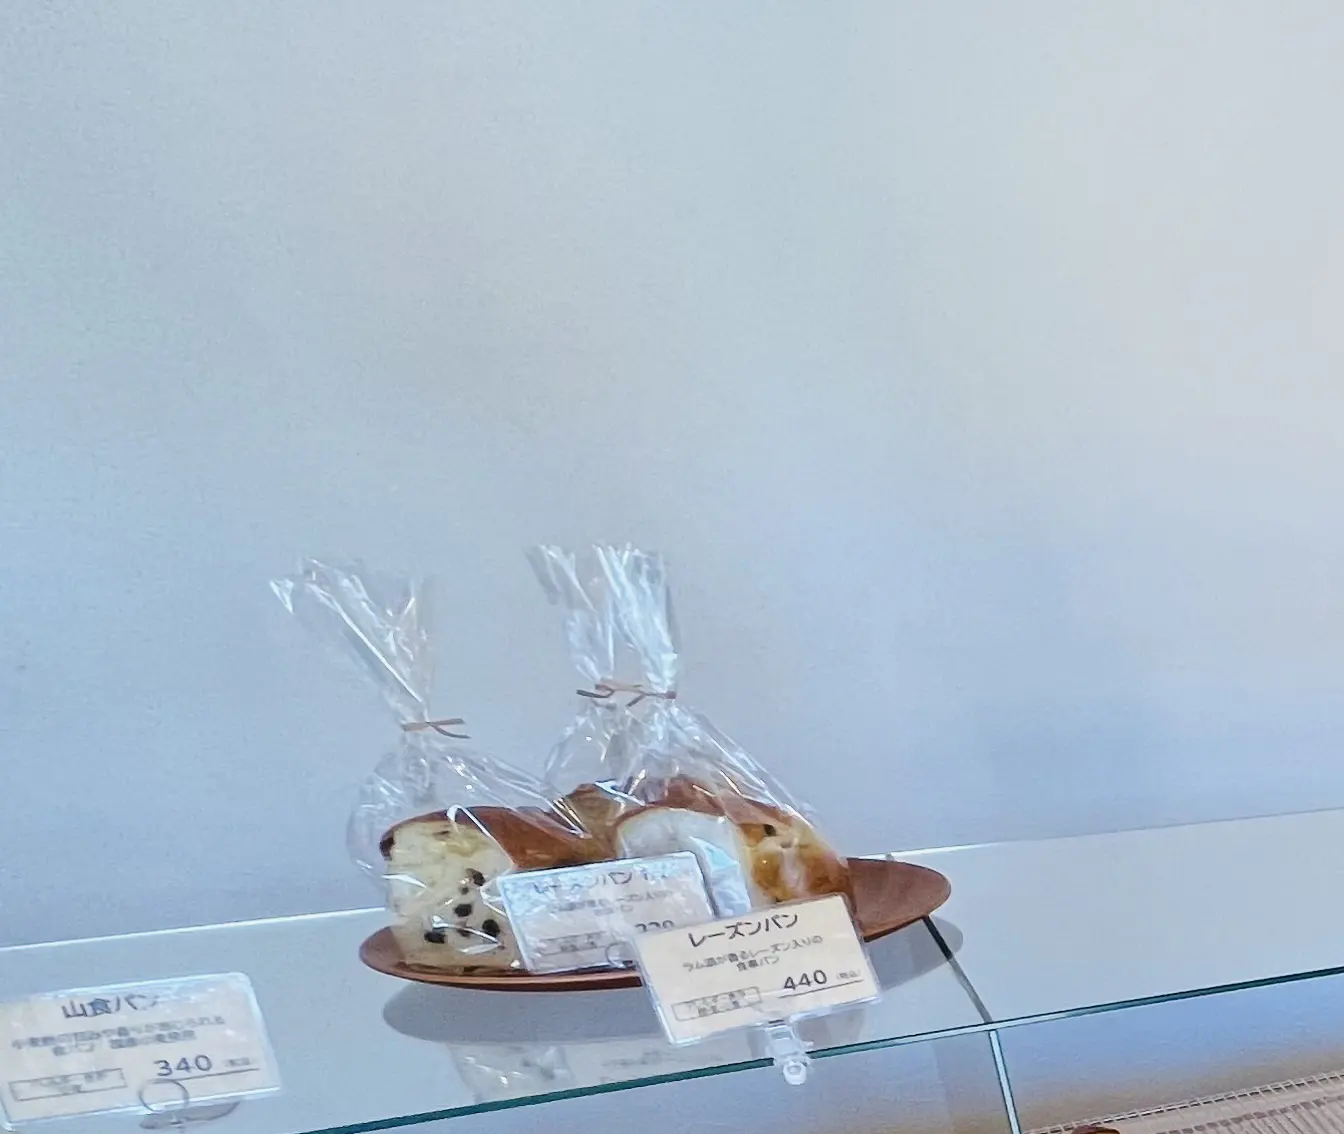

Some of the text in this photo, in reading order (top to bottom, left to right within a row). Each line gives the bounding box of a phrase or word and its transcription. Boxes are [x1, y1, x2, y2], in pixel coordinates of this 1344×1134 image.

[688, 914, 798, 947] レーズンパン
[784, 969, 828, 991] 440
[153, 1054, 213, 1077] 340
